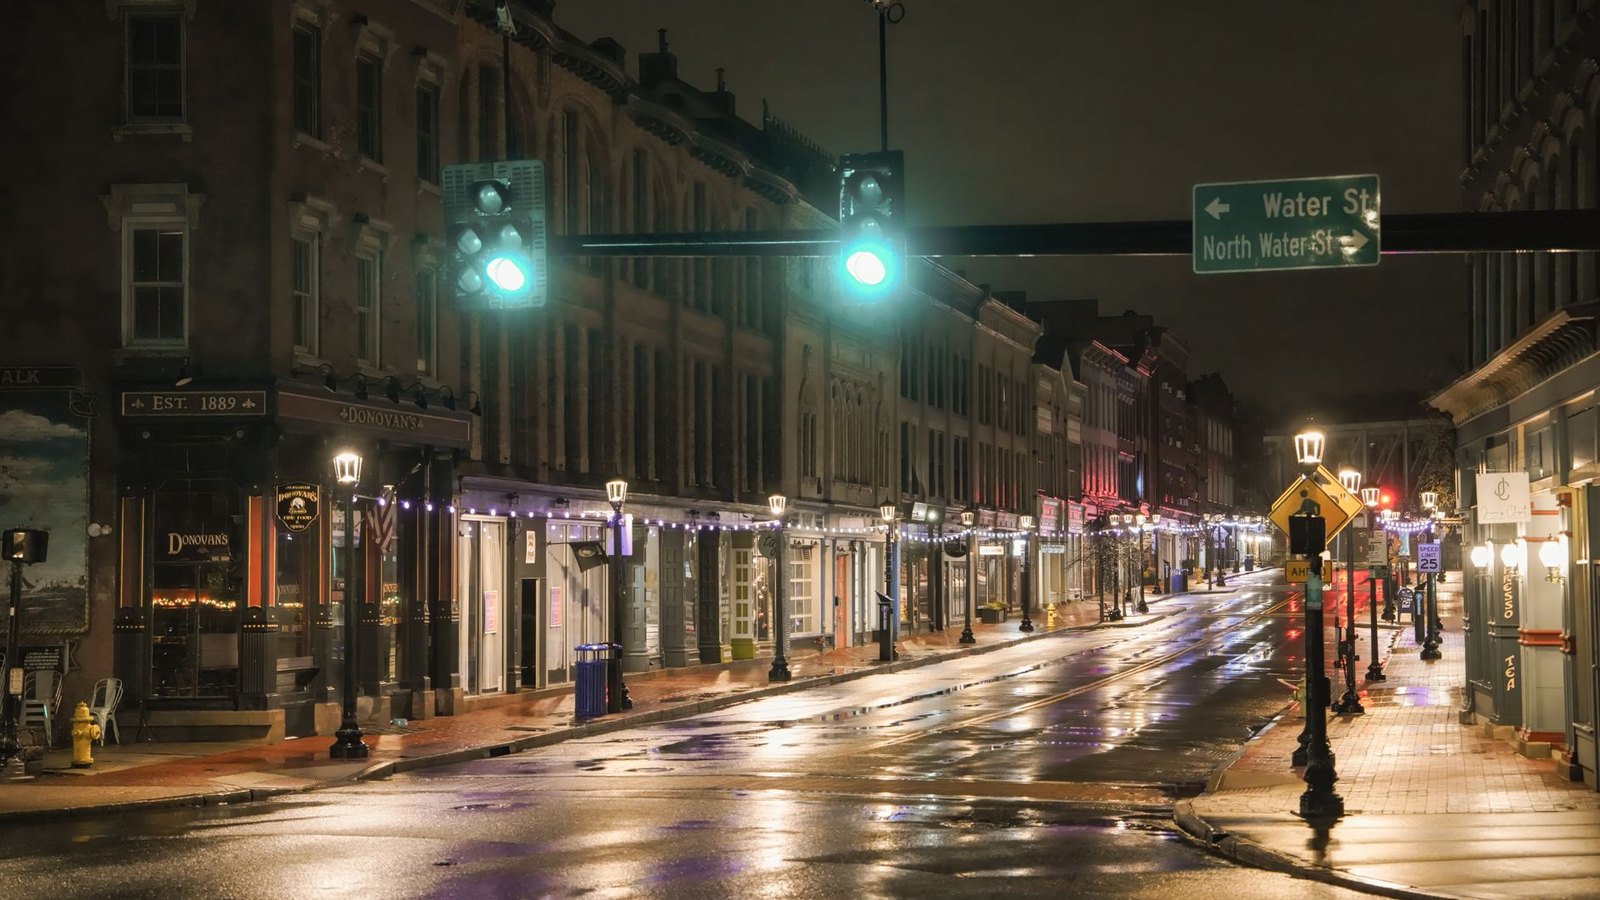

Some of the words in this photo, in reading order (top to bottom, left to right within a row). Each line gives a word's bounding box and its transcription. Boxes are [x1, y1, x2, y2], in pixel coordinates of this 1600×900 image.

[1262, 191, 1332, 219] Water
[1343, 187, 1369, 215] St
[1203, 234, 1252, 261] North
[1259, 232, 1308, 258] Water
[1315, 228, 1333, 256] St
[1, 370, 40, 383] ALK
[152, 395, 188, 410] EST.
[201, 396, 236, 410] 1889
[348, 406, 417, 430] DONOVAN'S
[167, 532, 229, 555] DONOVAN'S
[1420, 558, 1438, 569] 25
[1505, 655, 1515, 691] TEA
